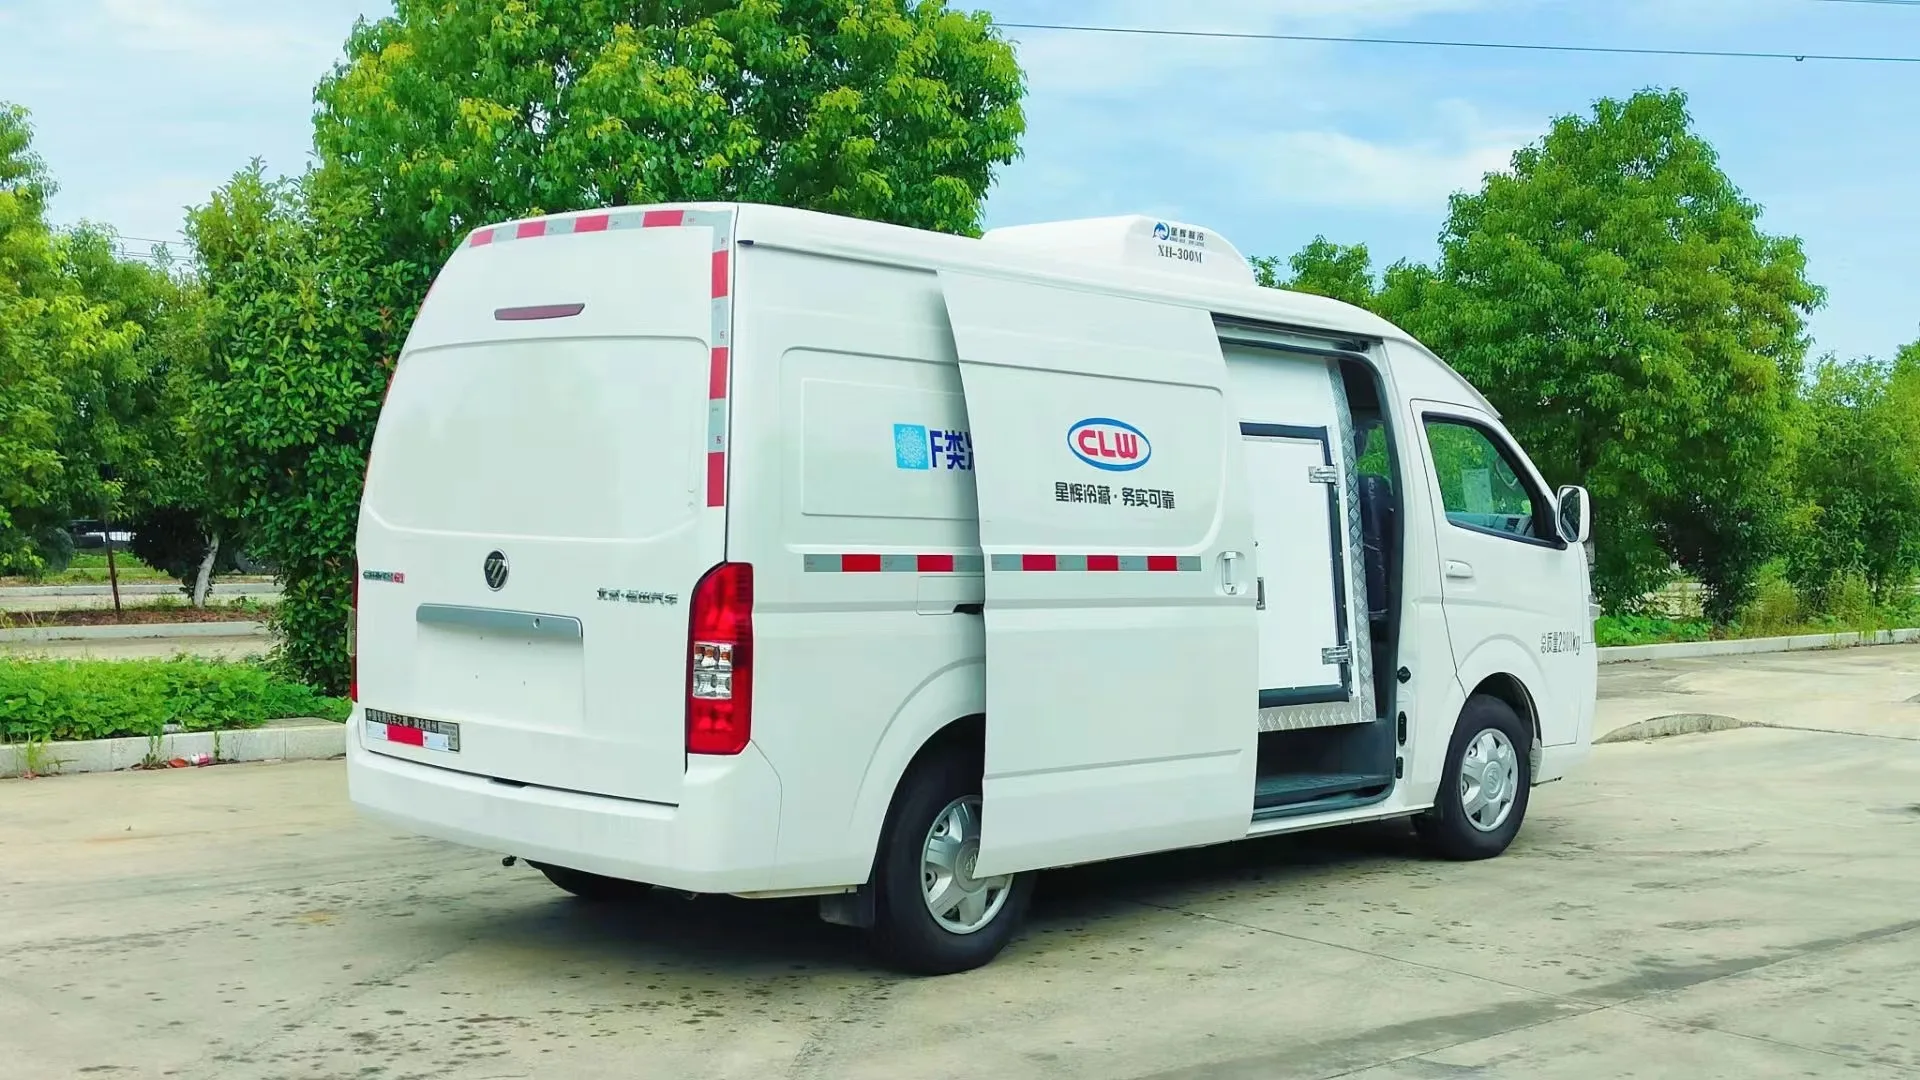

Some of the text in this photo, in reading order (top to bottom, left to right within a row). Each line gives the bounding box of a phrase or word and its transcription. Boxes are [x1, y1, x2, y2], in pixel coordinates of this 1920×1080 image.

[1157, 244, 1203, 263] XH-300M
[930, 430, 973, 470] F类
[1077, 429, 1138, 459] CLW
